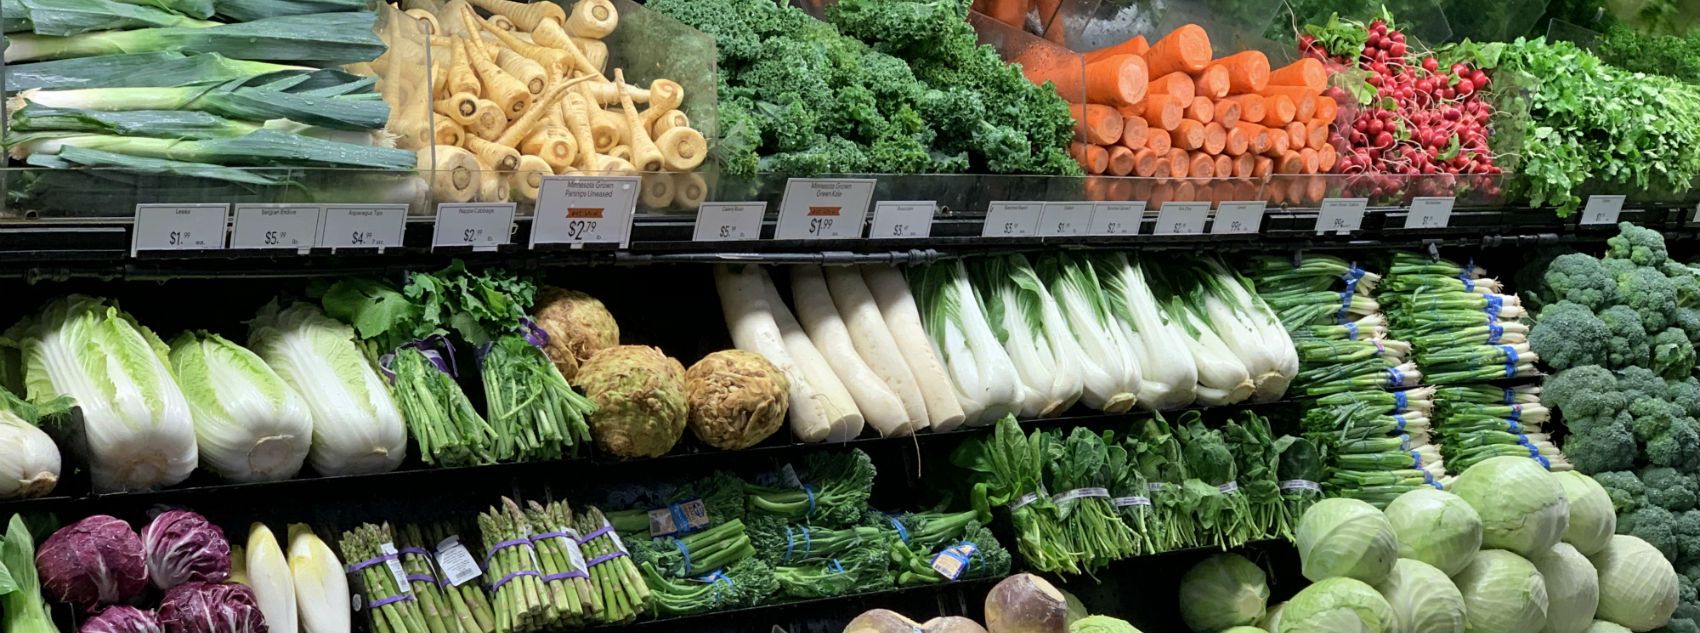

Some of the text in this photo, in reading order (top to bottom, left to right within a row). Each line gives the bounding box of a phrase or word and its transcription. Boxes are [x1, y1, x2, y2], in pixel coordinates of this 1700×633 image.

[567, 180, 614, 189] Minnesota Grown
[568, 220, 597, 240] $2.79
[809, 218, 833, 236] $1.99
[170, 232, 191, 245] $1.99
